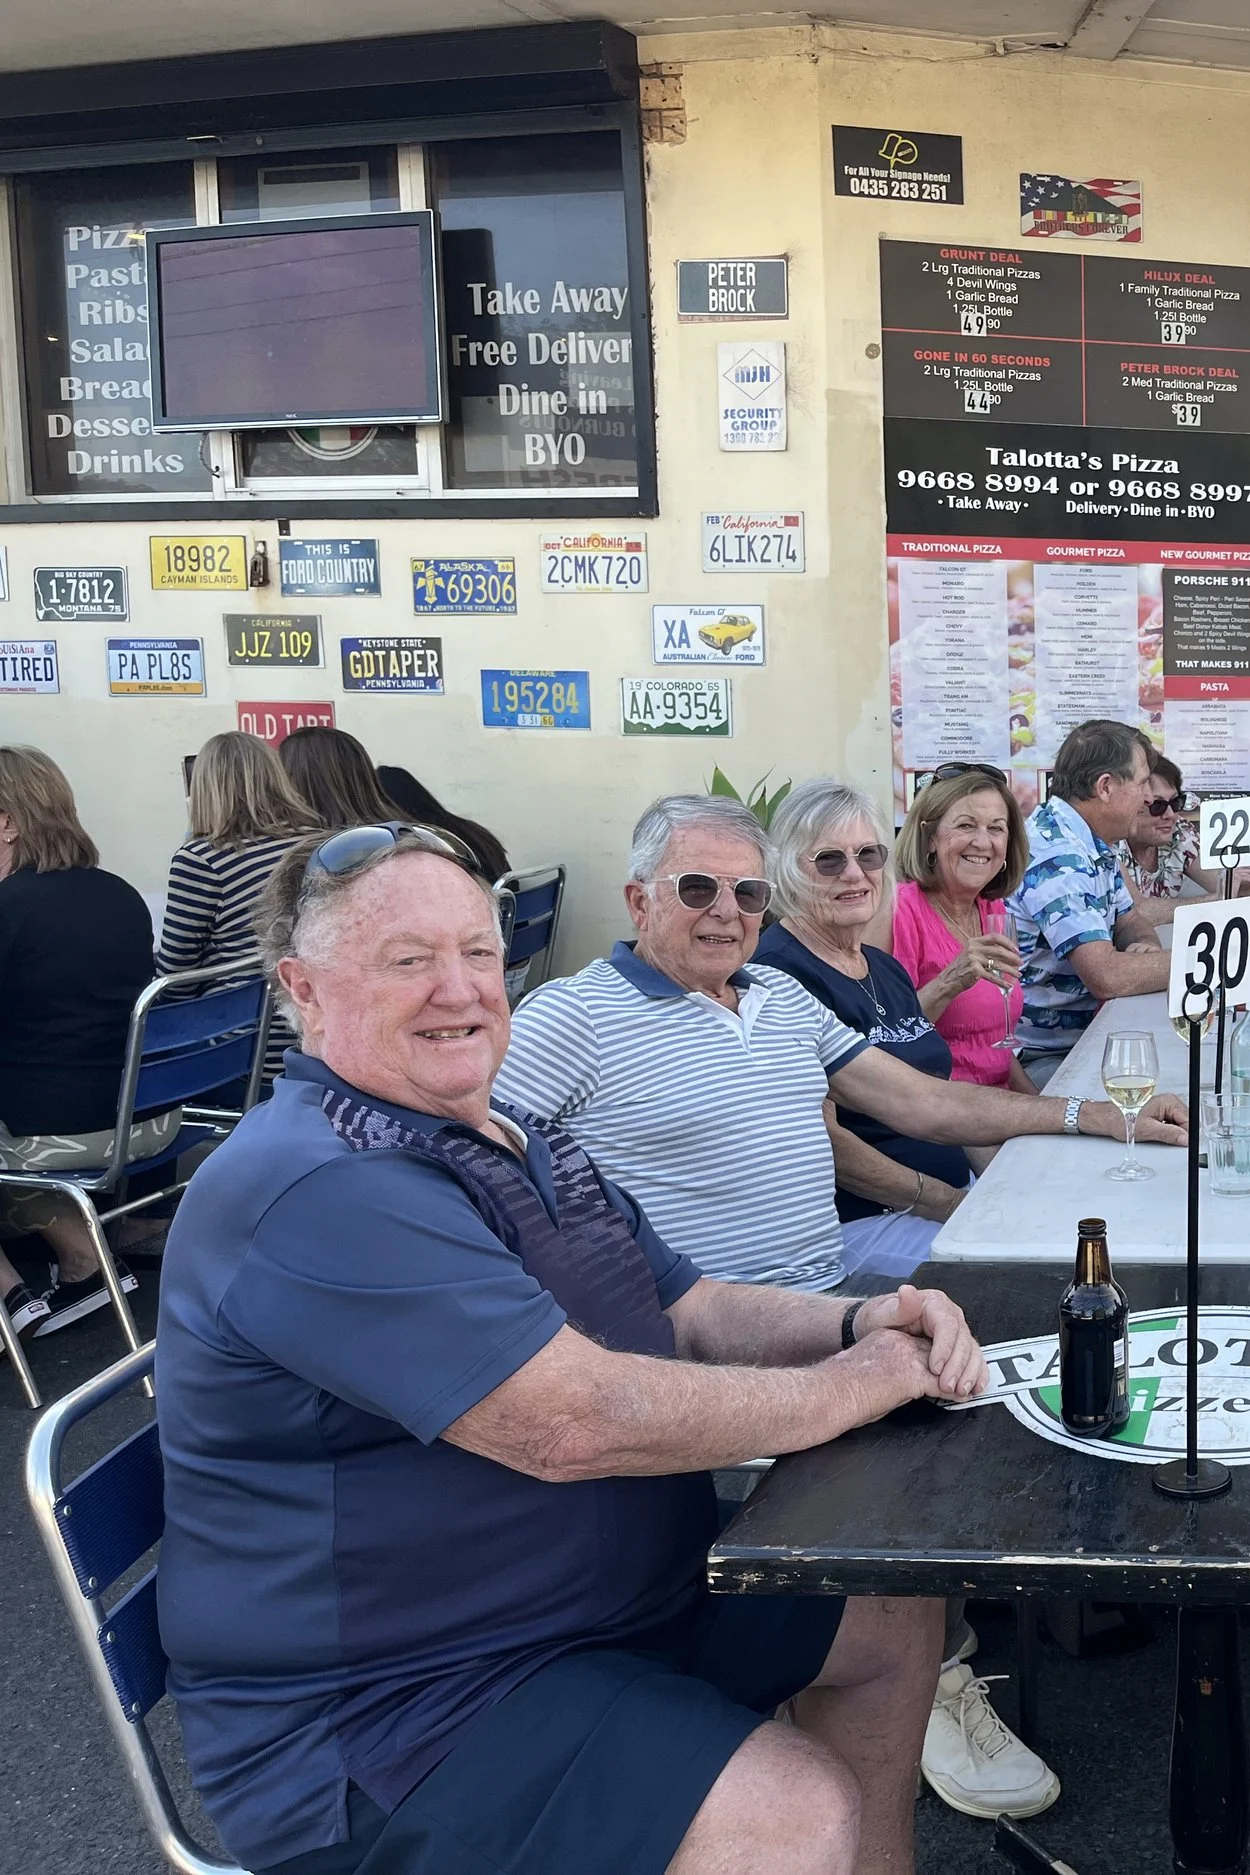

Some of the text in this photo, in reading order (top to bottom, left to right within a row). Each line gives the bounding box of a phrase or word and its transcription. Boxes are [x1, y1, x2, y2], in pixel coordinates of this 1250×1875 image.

[844, 166, 951, 183] For All Your Signage Needs!
[850, 178, 946, 201] 0435 283 251
[68, 226, 153, 251] Pizz
[940, 249, 1022, 263] GRUNT DEAL
[67, 264, 148, 289] Past
[709, 263, 755, 286] PETER
[932, 263, 1041, 280] Lrg Traditional Pizzas
[1144, 271, 1215, 284] HILUX DEAL
[957, 277, 1017, 292] Devil Wings
[467, 280, 628, 319] Take Away
[709, 289, 755, 312] BROCK
[79, 300, 148, 326] Ribs
[452, 332, 632, 367] Free Deliver
[914, 350, 1051, 367] GONE IN 60 SECONDS
[1121, 363, 1239, 378] PETER BROCK DEAL
[60, 376, 151, 401] Brea
[498, 383, 607, 416] Dine in
[723, 408, 783, 419] SECURITY
[731, 420, 777, 431] GROUP
[524, 433, 586, 465] BYO
[68, 450, 184, 474] Drinks
[985, 447, 1180, 475] Talotta's Pizza
[898, 470, 975, 492] 9668
[985, 473, 1060, 495] 8994
[1069, 480, 1099, 497] or
[1109, 479, 1180, 500] 9668
[946, 496, 1022, 514] Take Away
[1066, 501, 1215, 519] Delivery Dine in BYO
[707, 515, 778, 533] FEB California
[305, 544, 350, 555] THIS IS
[563, 537, 623, 548] CALIFORNIA
[709, 535, 797, 563] 6LIK274
[902, 542, 1002, 554] TRADITIONAL PIZZA
[1046, 546, 1126, 558] GOURMET PIZZA
[165, 545, 232, 573] 18982
[1161, 550, 1184, 559] NEW
[1185, 551, 1232, 560] GOURMET
[282, 558, 375, 585] FORD COUNTRY
[439, 562, 489, 572] ALASKA
[547, 555, 642, 585] 2CMK720
[160, 574, 238, 585] CAYMAN ISLANDS
[447, 574, 515, 604] 69306
[1174, 576, 1250, 586] PORSCHE 911
[690, 608, 726, 616] Falcon GT
[251, 619, 292, 628] CALIFORNIA
[235, 631, 312, 658] JJZ 109
[363, 639, 423, 648] KEYSTONE STATE
[664, 620, 691, 649] XA
[118, 652, 192, 680] PA PL8S
[350, 650, 440, 678] GDTAPER
[366, 680, 425, 688] PENNSYLVANIA
[646, 682, 703, 690] COLORADO
[1201, 683, 1229, 691] PASTA
[491, 681, 579, 714] 195284
[1209, 809, 1250, 856] 22
[1185, 916, 1249, 995] 30
